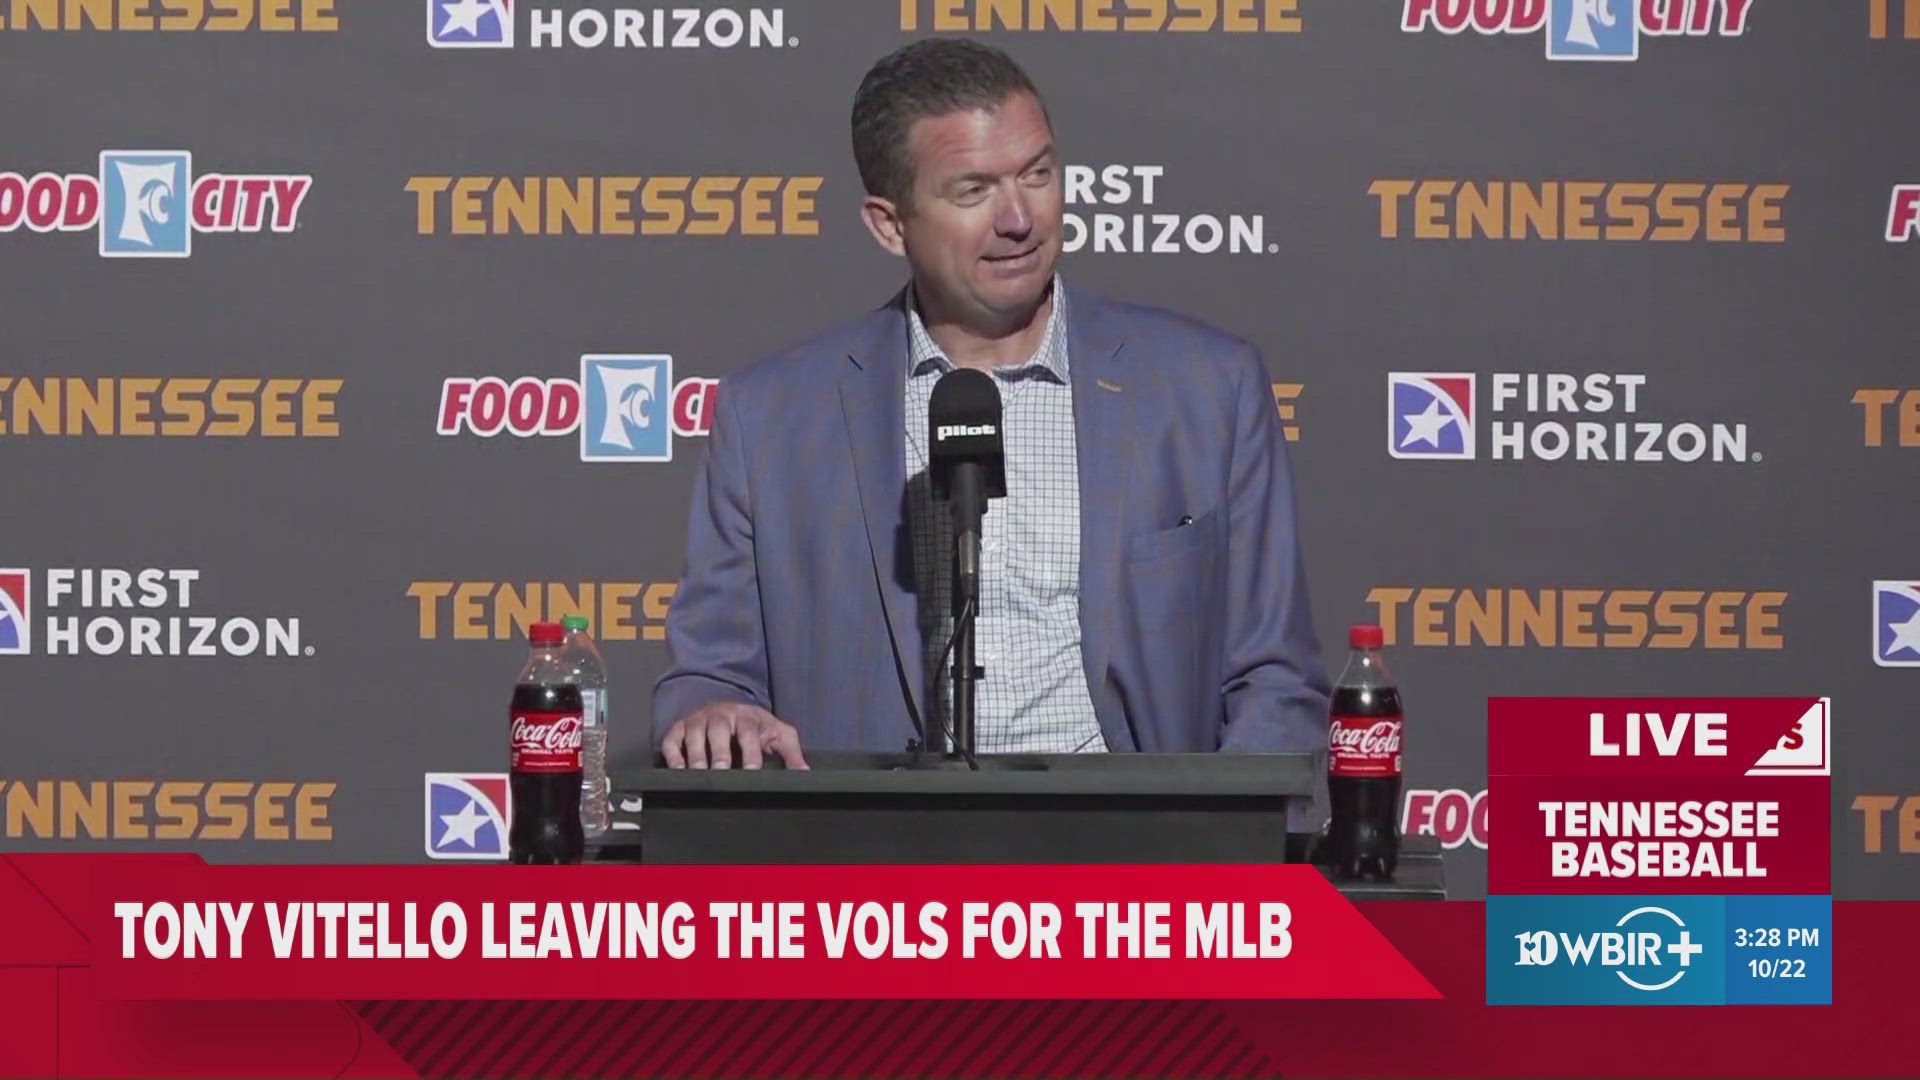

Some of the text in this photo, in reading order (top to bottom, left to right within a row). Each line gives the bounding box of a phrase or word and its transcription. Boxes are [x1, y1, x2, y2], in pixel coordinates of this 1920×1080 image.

[0, 0, 339, 31] NNESSEE
[0, 172, 100, 232] OOD
[191, 173, 312, 232] CITY
[404, 176, 823, 235] TENNESSEE
[1064, 164, 1164, 204] RST
[1367, 180, 1790, 241] TENNESSEE
[1062, 213, 1264, 254] ORIZON
[0, 377, 344, 437] NNESSEE
[436, 376, 581, 437] FOOD
[672, 376, 720, 436] CI
[1491, 373, 1646, 412] FIRST
[937, 424, 996, 441] pilot
[46, 569, 199, 608] FIRST
[405, 581, 679, 640] TENNES
[1365, 588, 1789, 649] TENNESSEE
[511, 716, 583, 749] Coca-Cola
[1329, 720, 1401, 753] Coca-Cola
[0, 781, 337, 840] NNESSEE
[1401, 789, 1488, 850] FO
